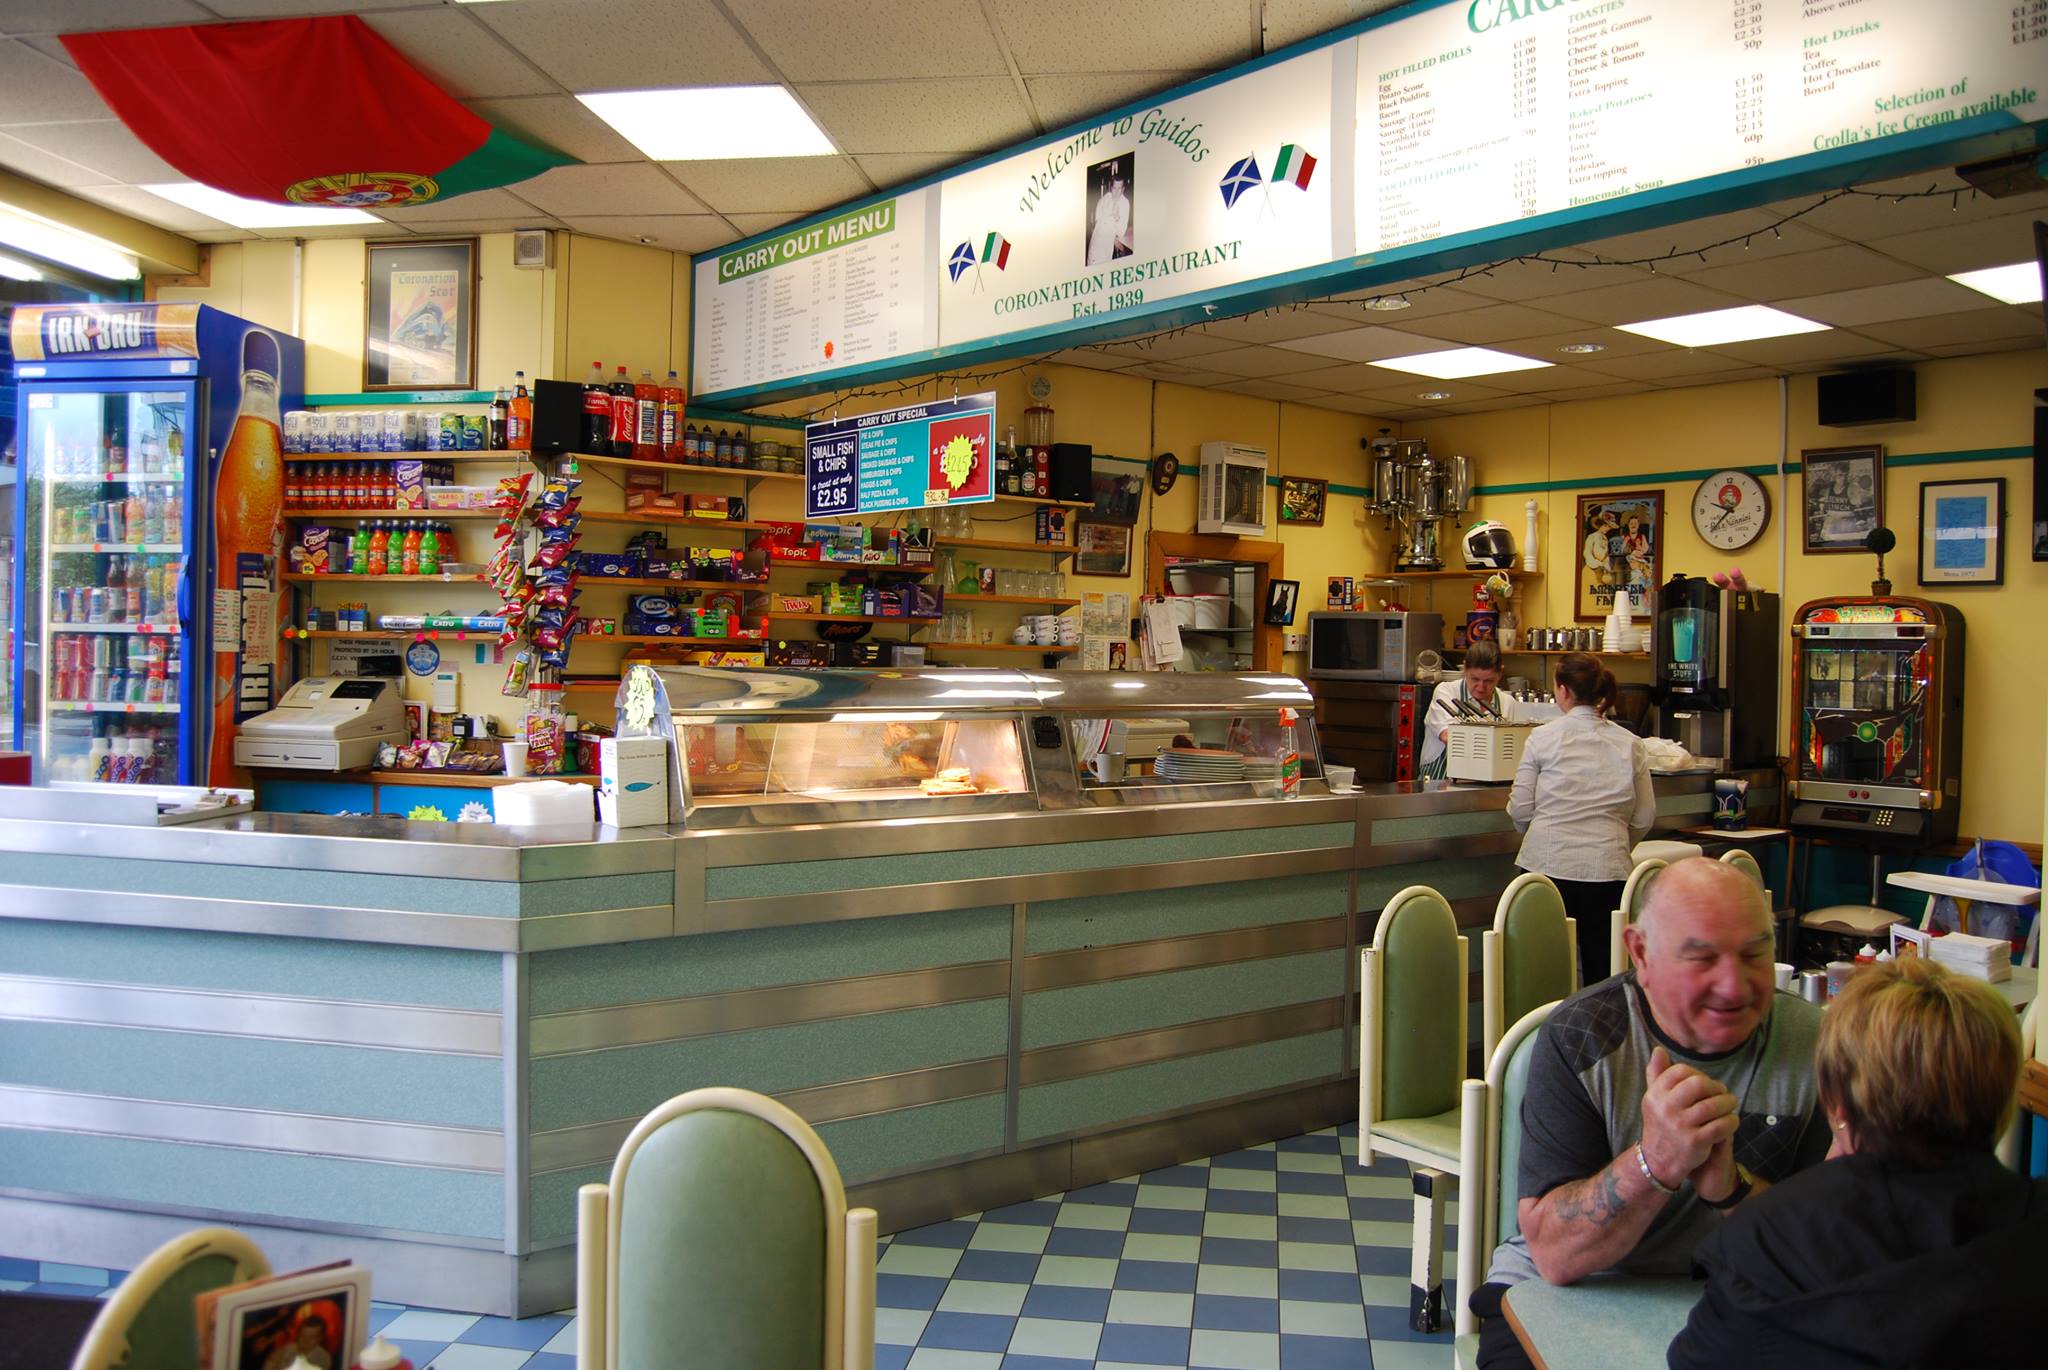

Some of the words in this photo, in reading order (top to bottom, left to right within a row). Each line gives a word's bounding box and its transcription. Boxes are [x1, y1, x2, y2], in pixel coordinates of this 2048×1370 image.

[1568, 0, 1624, 24] TOASTIES
[1803, 5, 1835, 19] Above
[1568, 17, 1607, 35] Gammon
[1568, 32, 1597, 46] Cheese
[1600, 28, 1608, 38] &
[1611, 15, 1651, 32] Gammon
[1803, 36, 1828, 48] Hot
[1832, 21, 1880, 41] Drinks
[1568, 42, 1597, 57] Cheese
[1568, 53, 1598, 67] Cheese
[1600, 48, 1608, 58] &
[1611, 40, 1639, 54] Onion
[1744, 39, 1762, 50] 50p
[1378, 69, 1400, 83] HOT
[1402, 57, 1436, 76] FILLED
[1439, 46, 1472, 64] ROLLS
[1568, 64, 1598, 78] Cheese
[1600, 59, 1608, 68] &
[1612, 51, 1645, 64] Tomato
[1803, 51, 1820, 60] Tea
[1803, 58, 1837, 73] Coffee
[1803, 74, 1823, 85] Hot
[1826, 59, 1881, 79] Chocolate
[1379, 83, 1392, 92] Egg
[1569, 77, 1589, 88] Tuna
[1569, 87, 1590, 99] Extra
[1594, 76, 1628, 92] Topping
[1803, 82, 1835, 96] Bovril
[1379, 90, 1401, 102] Potato
[1379, 98, 1398, 111] Black
[1400, 90, 1430, 105] Pudding
[1875, 86, 1944, 114] Selection
[1951, 78, 1968, 94] of
[1814, 126, 1871, 151] Crolla's
[1876, 121, 1897, 137] Ice
[1904, 108, 1955, 131] Cream
[1961, 88, 2036, 119] available
[1020, 128, 1103, 214] Welcome
[1112, 116, 1133, 139] to
[1139, 108, 1210, 162] Guidos
[1569, 175, 1591, 184] Extra
[1594, 166, 1628, 179] topping
[1569, 185, 1632, 206] Homemade
[1635, 179, 1663, 191] Soup
[722, 244, 779, 278] CARRY
[782, 230, 823, 258] OUT
[828, 208, 890, 245] MENU
[994, 274, 1104, 316] CORONATION
[1110, 240, 1242, 288] RESTAURANT
[1072, 300, 1102, 320] Est.
[1108, 288, 1144, 311] 1939
[858, 416, 880, 427] CARRY
[882, 413, 896, 423] OUT
[898, 408, 928, 420] SPECIAL
[872, 430, 884, 438] CHIPS
[812, 445, 835, 459] SMALL
[837, 441, 853, 456] FISH
[884, 448, 896, 456] CHIPS
[818, 460, 823, 472] &
[825, 457, 846, 471] CHIPS
[832, 477, 839, 485] at
[840, 473, 852, 484] only
[818, 488, 847, 507] £2.95
[782, 547, 807, 558] Topic
[1596, 595, 1639, 606] FARI
